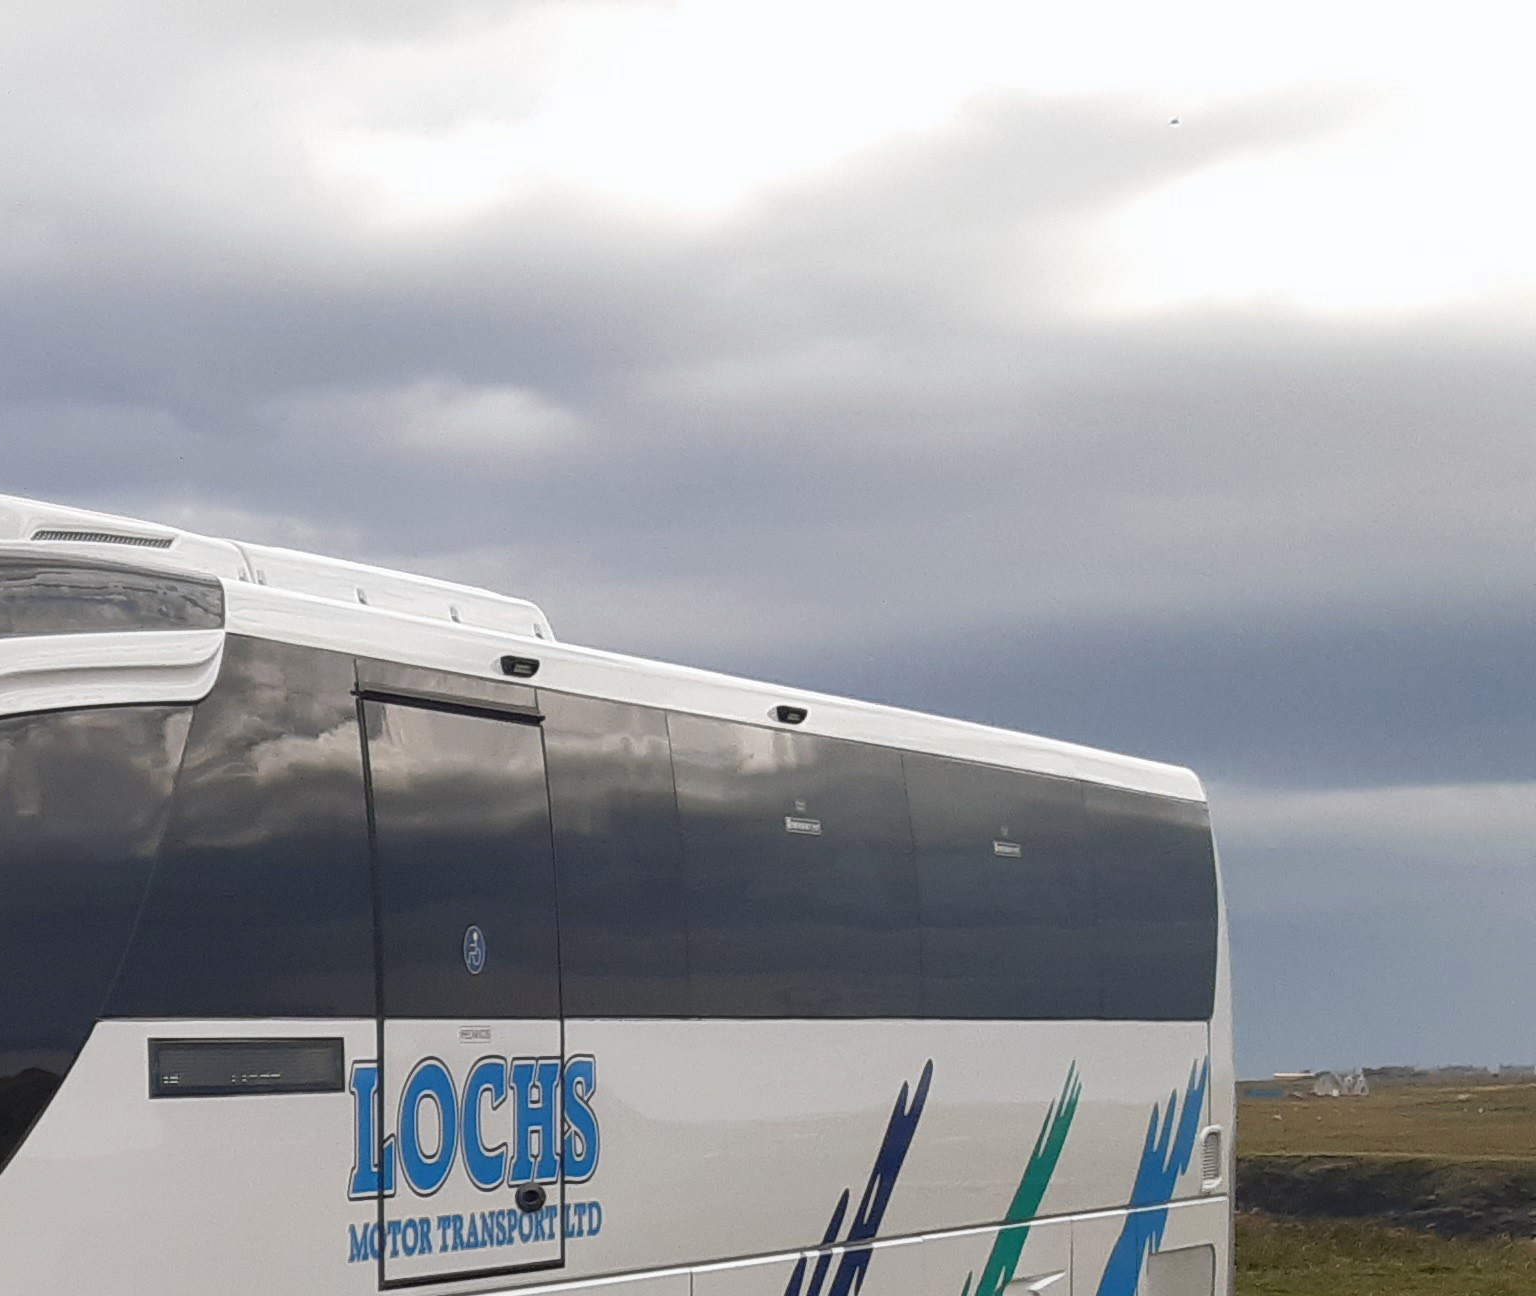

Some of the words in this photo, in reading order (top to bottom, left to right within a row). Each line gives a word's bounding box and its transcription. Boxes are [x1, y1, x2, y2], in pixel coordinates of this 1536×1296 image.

[348, 1054, 600, 1201] LOCHS
[348, 1216, 432, 1263] MOTOR
[436, 1203, 558, 1254] TRANSPORT
[562, 1200, 603, 1239] LTD
